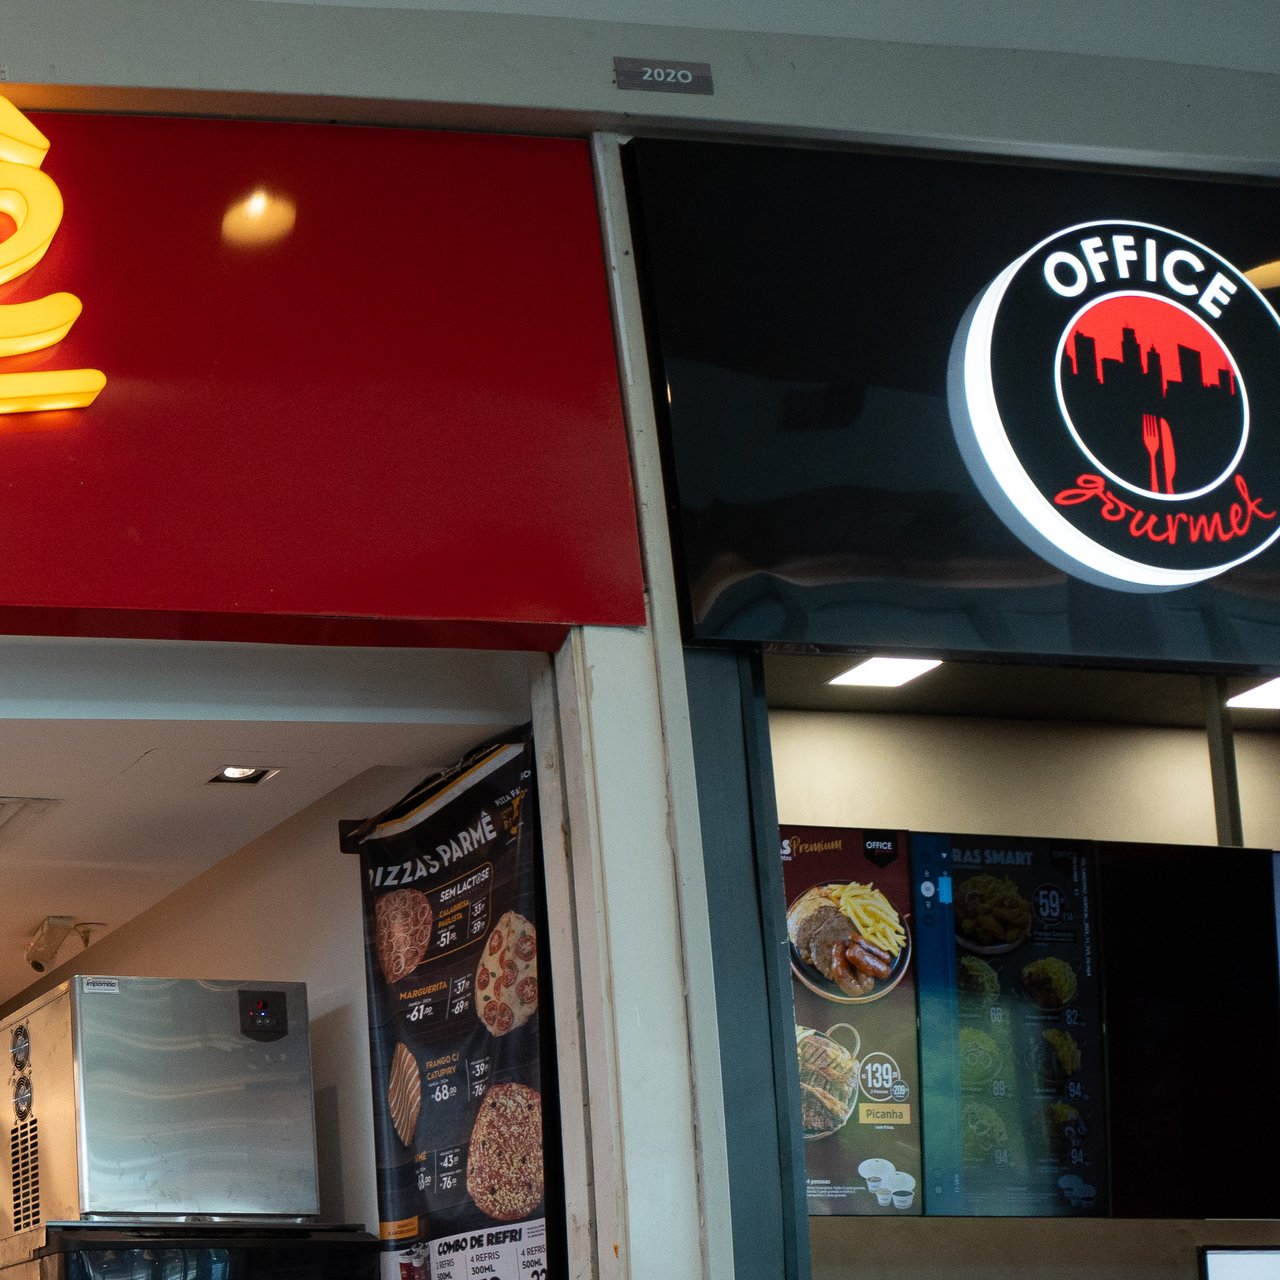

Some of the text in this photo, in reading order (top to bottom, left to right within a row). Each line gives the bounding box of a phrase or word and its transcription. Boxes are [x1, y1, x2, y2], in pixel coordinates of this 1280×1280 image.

[1042, 235, 1238, 319] OFFICE
[1053, 473, 1277, 545] gourmet
[436, 810, 497, 866] PARMÊ
[865, 839, 892, 851] OFFICE
[791, 837, 843, 856] Premium
[985, 849, 1033, 866] SMART
[440, 885, 455, 902] SEM
[400, 980, 447, 1000] MARGUERITA
[426, 1056, 451, 1070] FRANGO
[426, 1067, 456, 1081] CATUPIRY
[865, 1108, 904, 1122] Picanha
[438, 1239, 468, 1256] COMBO
[470, 1235, 484, 1249] DE
[487, 1228, 522, 1246] REFRI
[476, 1251, 500, 1262] REFRIS
[525, 1245, 546, 1255] REFRIS
[472, 1265, 495, 1275] 300ML
[522, 1260, 543, 1269] 500ML
